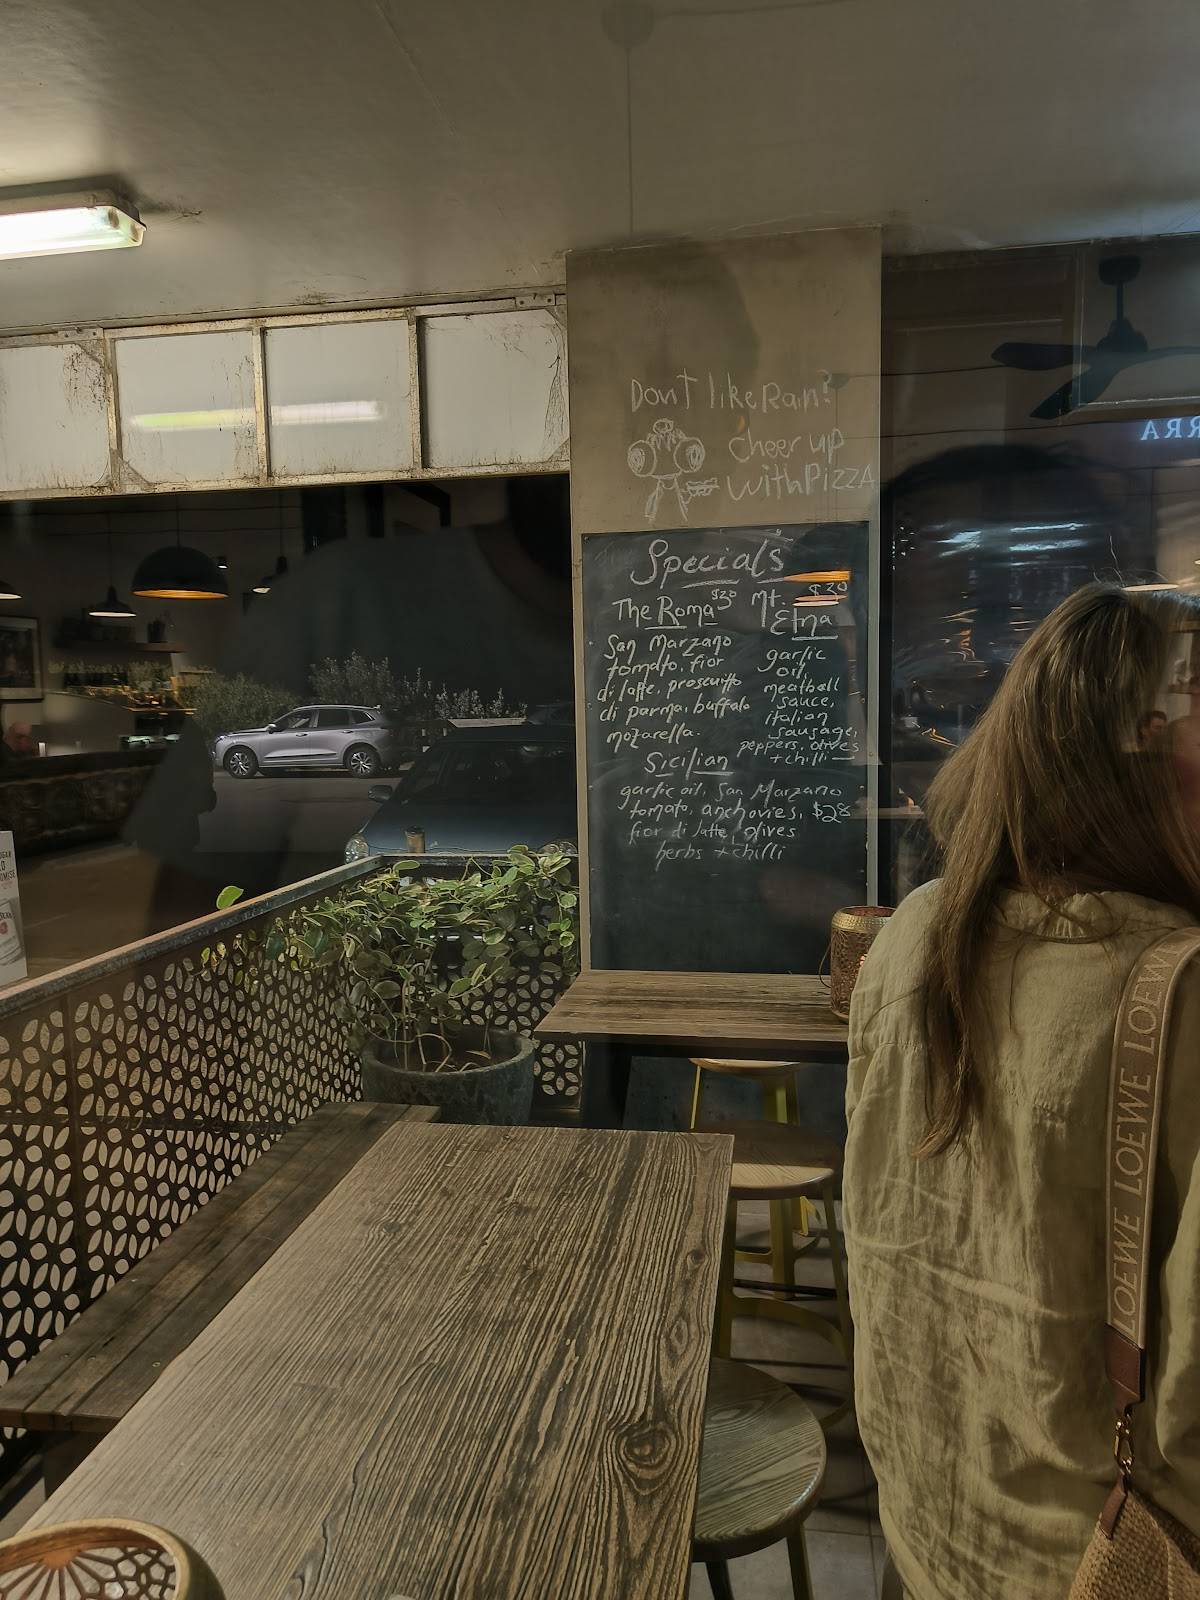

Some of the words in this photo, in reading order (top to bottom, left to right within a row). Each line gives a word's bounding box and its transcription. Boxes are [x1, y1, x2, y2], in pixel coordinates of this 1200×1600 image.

[709, 372, 758, 409] like
[630, 539, 784, 589] Specials
[611, 597, 652, 628] The
[656, 595, 715, 628] Roma
[769, 607, 832, 637] Etna
[603, 633, 636, 665] San
[648, 632, 733, 669] Marzano
[690, 653, 725, 673] fior
[756, 645, 827, 673] garlic
[763, 676, 841, 702] meatball
[600, 700, 620, 722] di
[693, 692, 751, 719] buffalo
[644, 747, 729, 780] Sicilian
[617, 781, 676, 811] garlic
[714, 781, 744, 802] San
[749, 778, 842, 809] Marzano
[628, 820, 664, 845] fior
[671, 820, 689, 839] di
[655, 839, 704, 872] herbs
[1114, 1067, 1151, 1197] LOEWE
[1112, 1207, 1141, 1335] LOEWE
